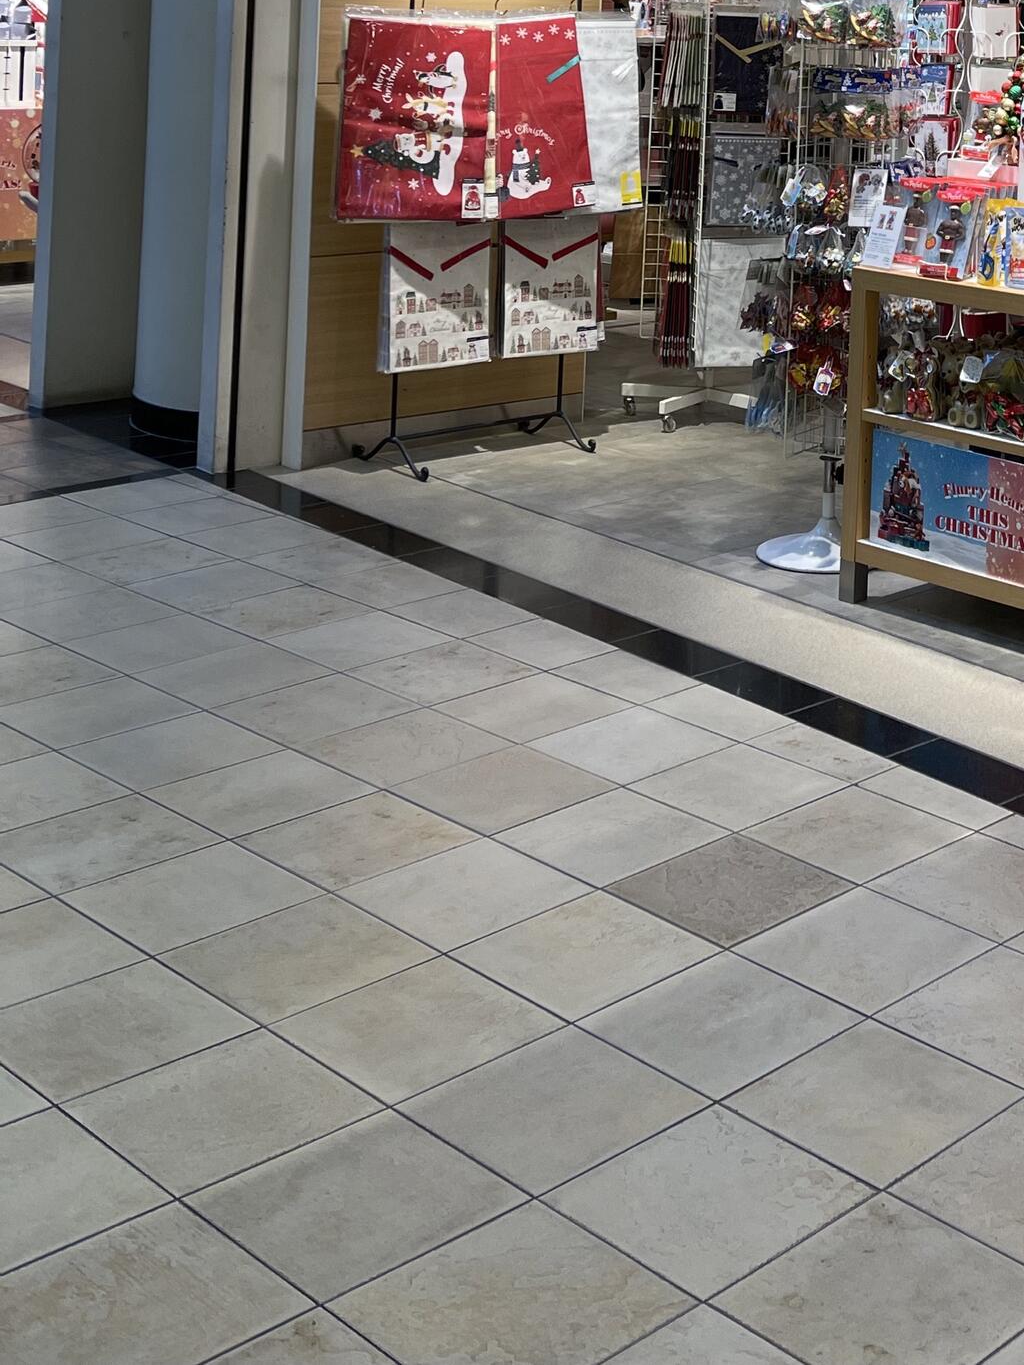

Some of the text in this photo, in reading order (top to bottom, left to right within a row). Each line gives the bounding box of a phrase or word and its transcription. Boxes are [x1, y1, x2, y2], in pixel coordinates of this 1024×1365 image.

[372, 64, 391, 92] Merry
[943, 482, 987, 502] Flurry
[967, 505, 1009, 531] THIS
